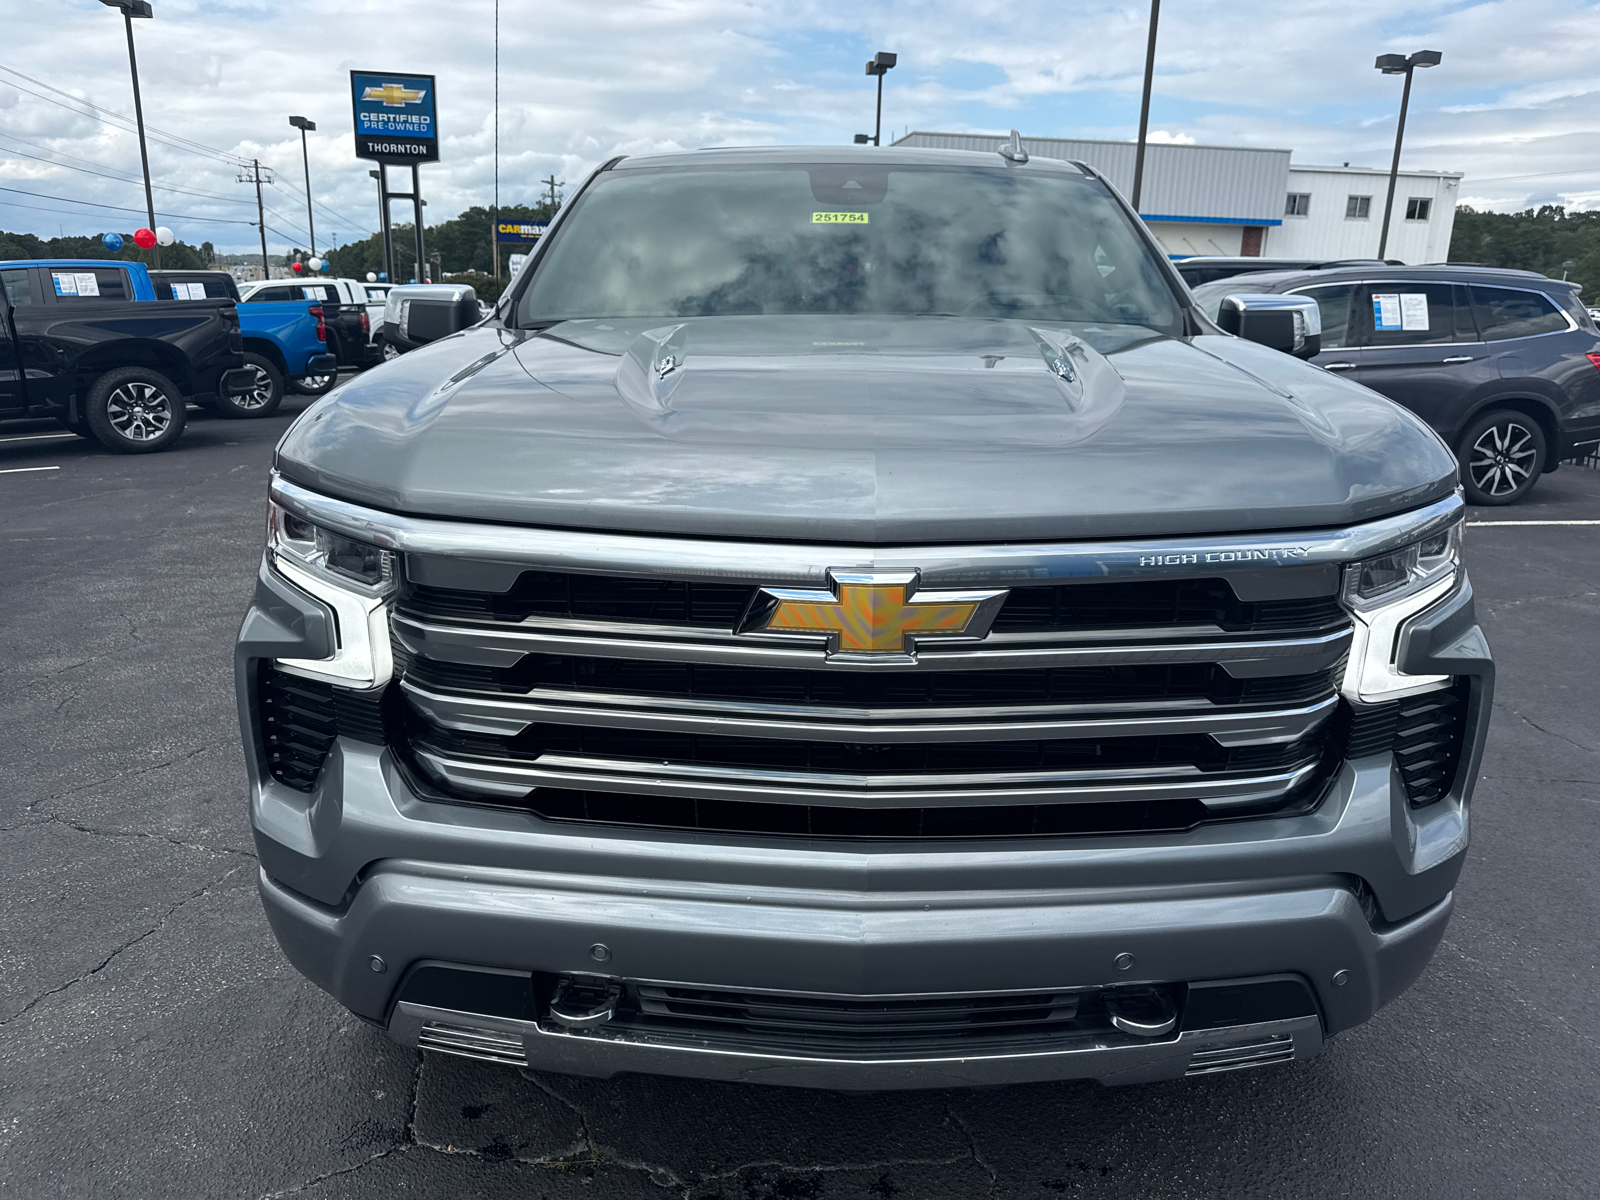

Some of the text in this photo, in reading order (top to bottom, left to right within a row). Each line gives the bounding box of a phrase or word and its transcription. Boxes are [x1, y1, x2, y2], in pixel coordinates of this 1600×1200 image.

[360, 112, 430, 123] CERTIFIED
[363, 121, 428, 132] PRE-OWNED
[367, 143, 427, 154] THORNTON
[814, 213, 865, 222] 251754
[1139, 547, 1312, 566] HIGH COUNTRY
